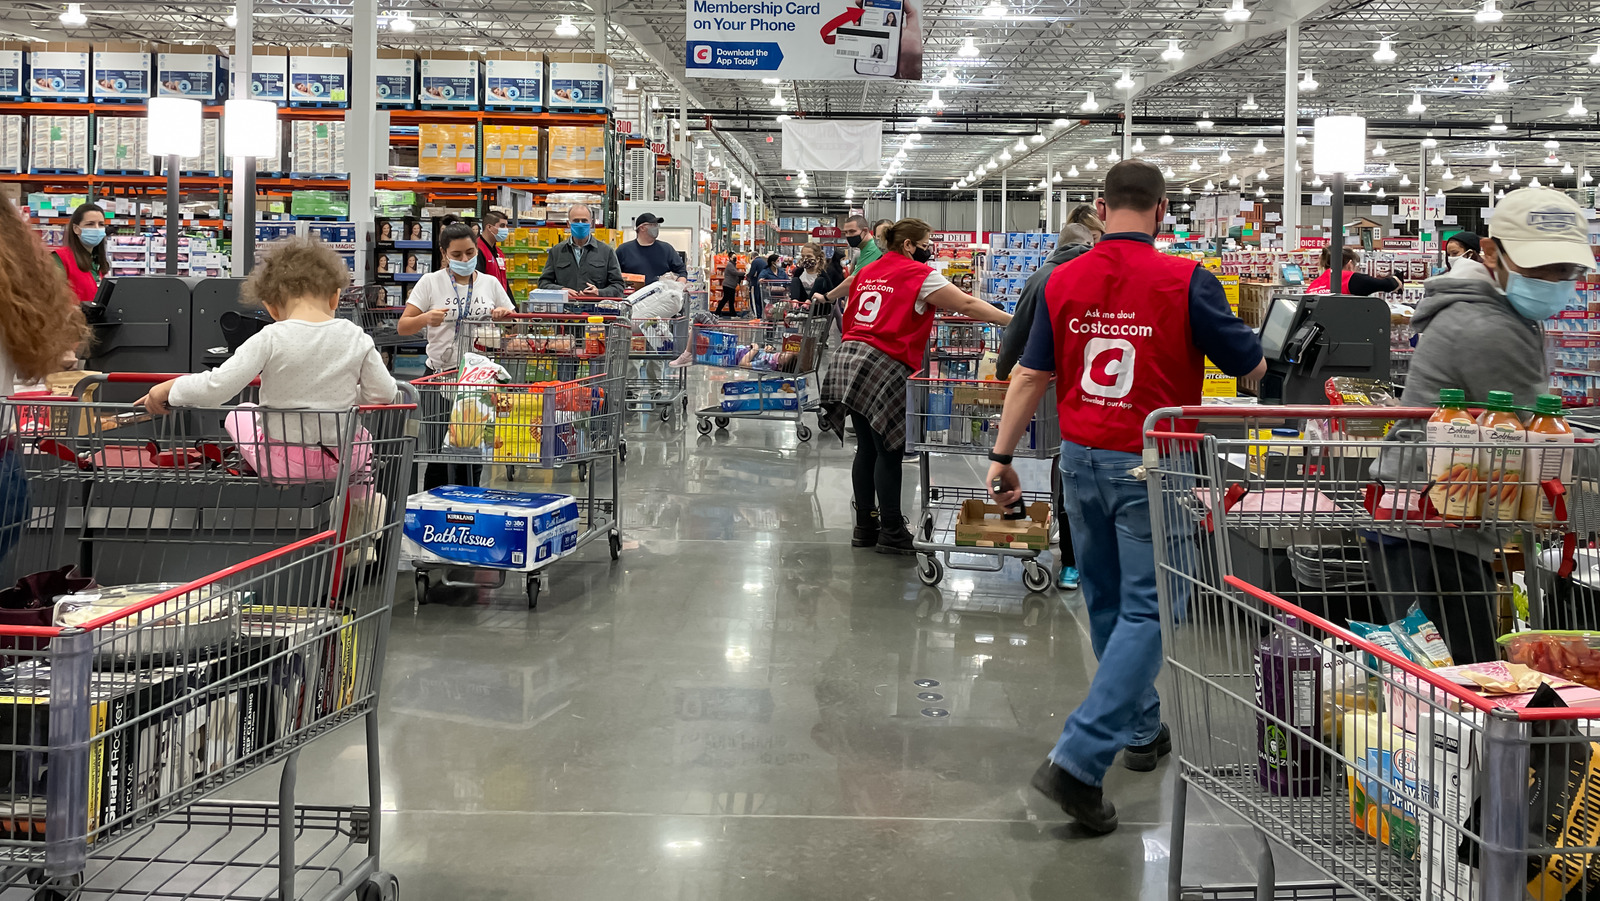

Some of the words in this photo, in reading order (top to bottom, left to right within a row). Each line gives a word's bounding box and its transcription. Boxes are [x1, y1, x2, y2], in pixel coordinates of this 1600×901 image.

[693, 1, 783, 17] Membership
[785, 2, 820, 15] Card
[693, 20, 712, 30] on
[714, 18, 746, 31] Your
[750, 18, 795, 31] Phone
[717, 48, 755, 57] Download
[756, 49, 768, 57] the
[717, 57, 732, 66] App
[734, 57, 758, 66] Today!
[616, 120, 632, 134] 300
[652, 143, 666, 154] 302
[445, 296, 486, 306] SOCAL
[1085, 309, 1100, 318] Ask
[1068, 318, 1152, 337] Costco.com
[1118, 400, 1132, 409] App
[422, 524, 458, 544] Bath
[458, 527, 496, 548] Tissue
